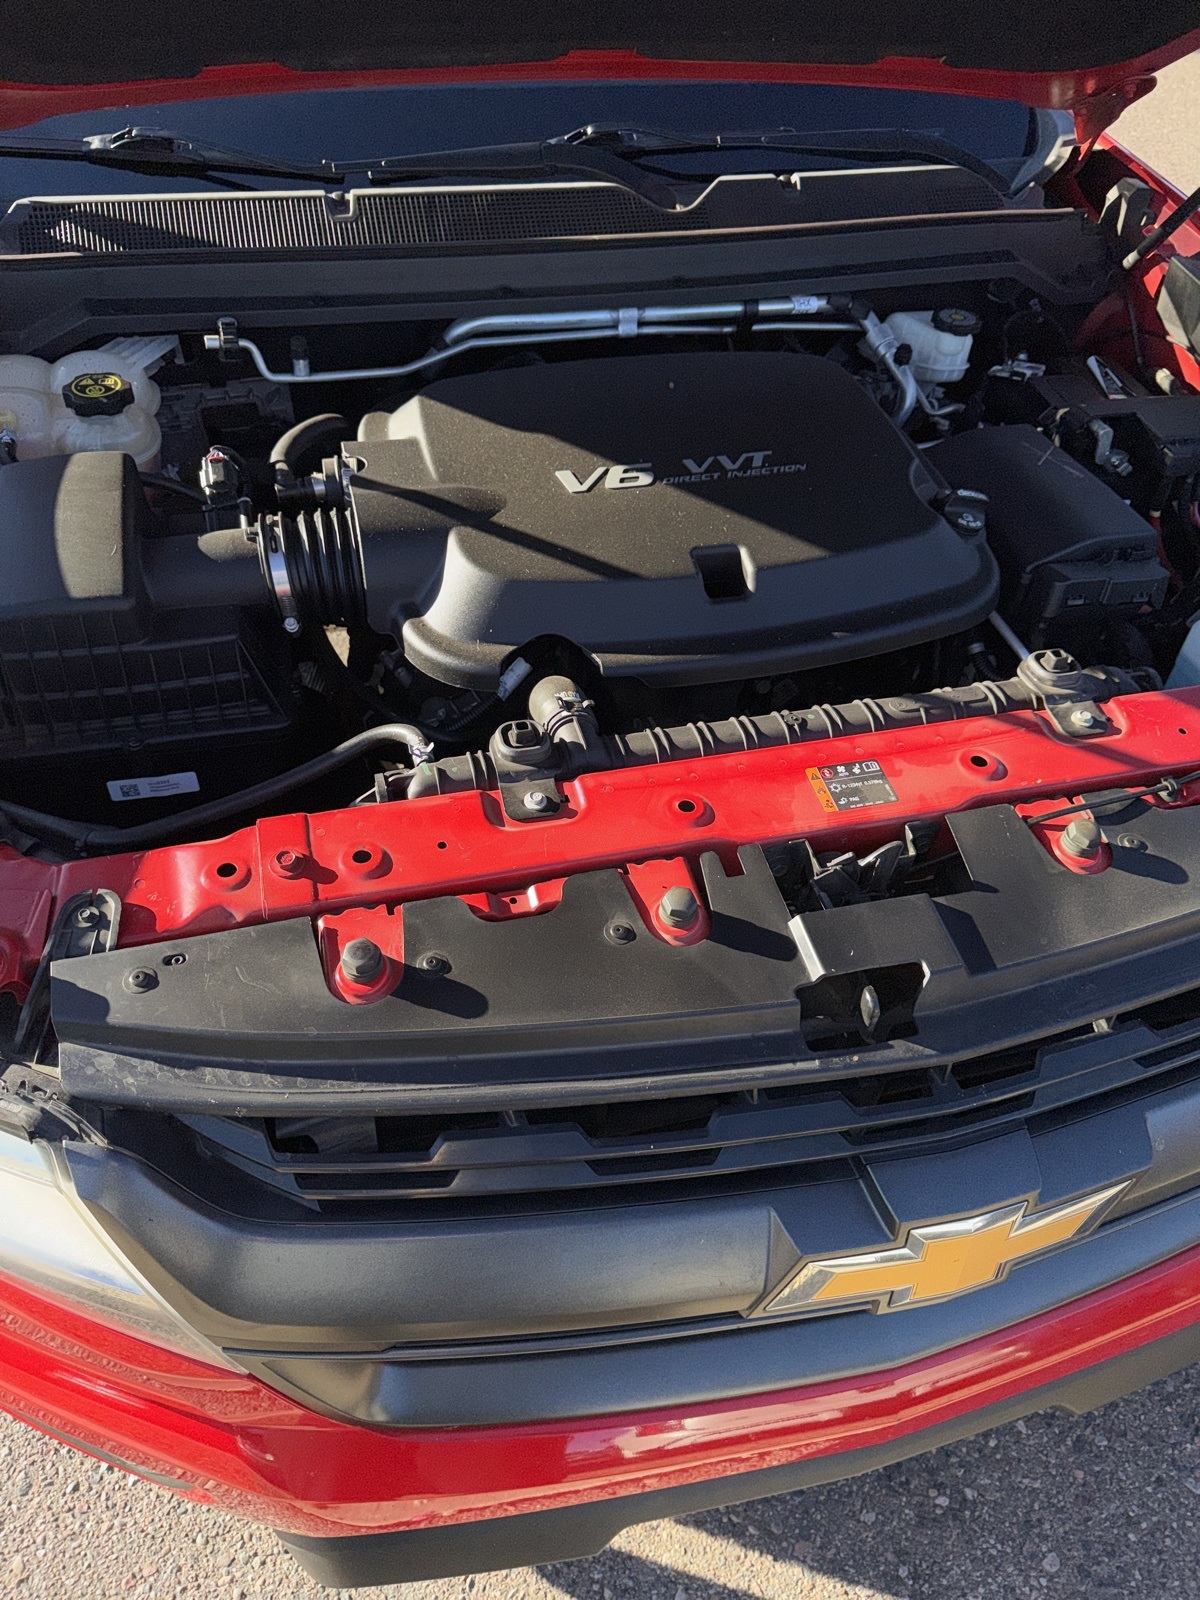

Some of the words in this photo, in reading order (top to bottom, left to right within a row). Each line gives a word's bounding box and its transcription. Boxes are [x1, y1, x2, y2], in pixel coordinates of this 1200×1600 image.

[555, 463, 654, 493] V6
[682, 450, 772, 473] VVT
[663, 472, 721, 485] DIRECT
[727, 464, 807, 478] INJECTION
